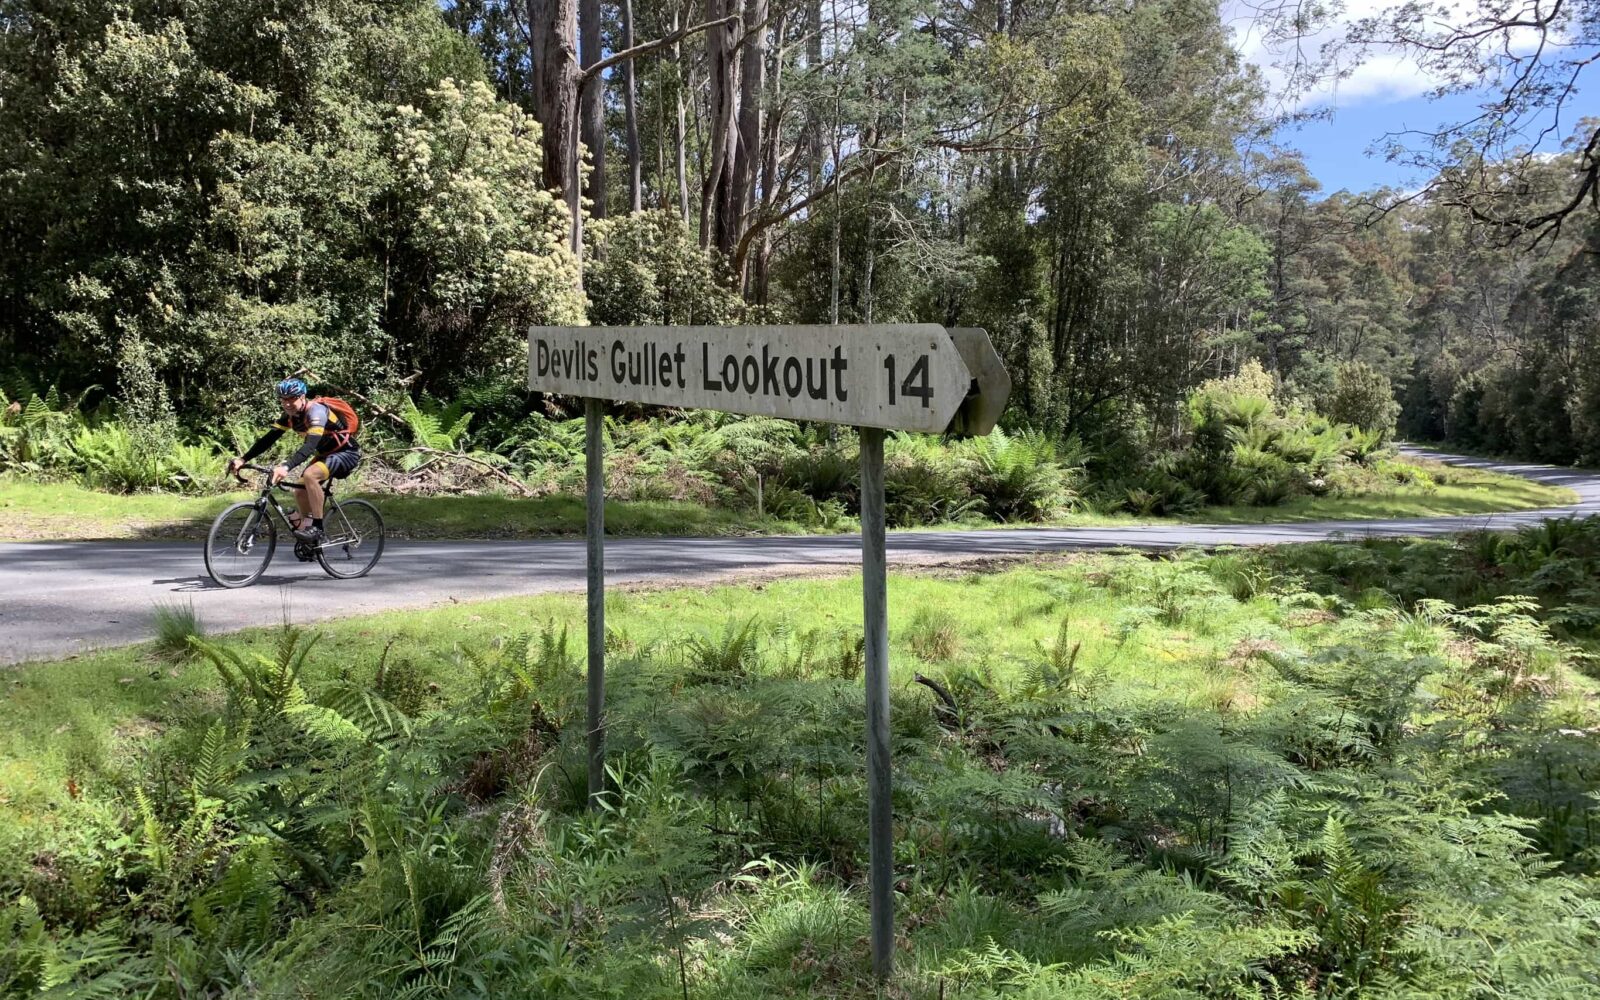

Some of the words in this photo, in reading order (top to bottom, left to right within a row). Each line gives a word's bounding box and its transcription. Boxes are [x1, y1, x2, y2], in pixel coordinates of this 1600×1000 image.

[537, 339, 599, 382] Devils
[611, 340, 686, 389] Gullet
[702, 342, 848, 402] Lookout
[883, 353, 934, 408] 14
